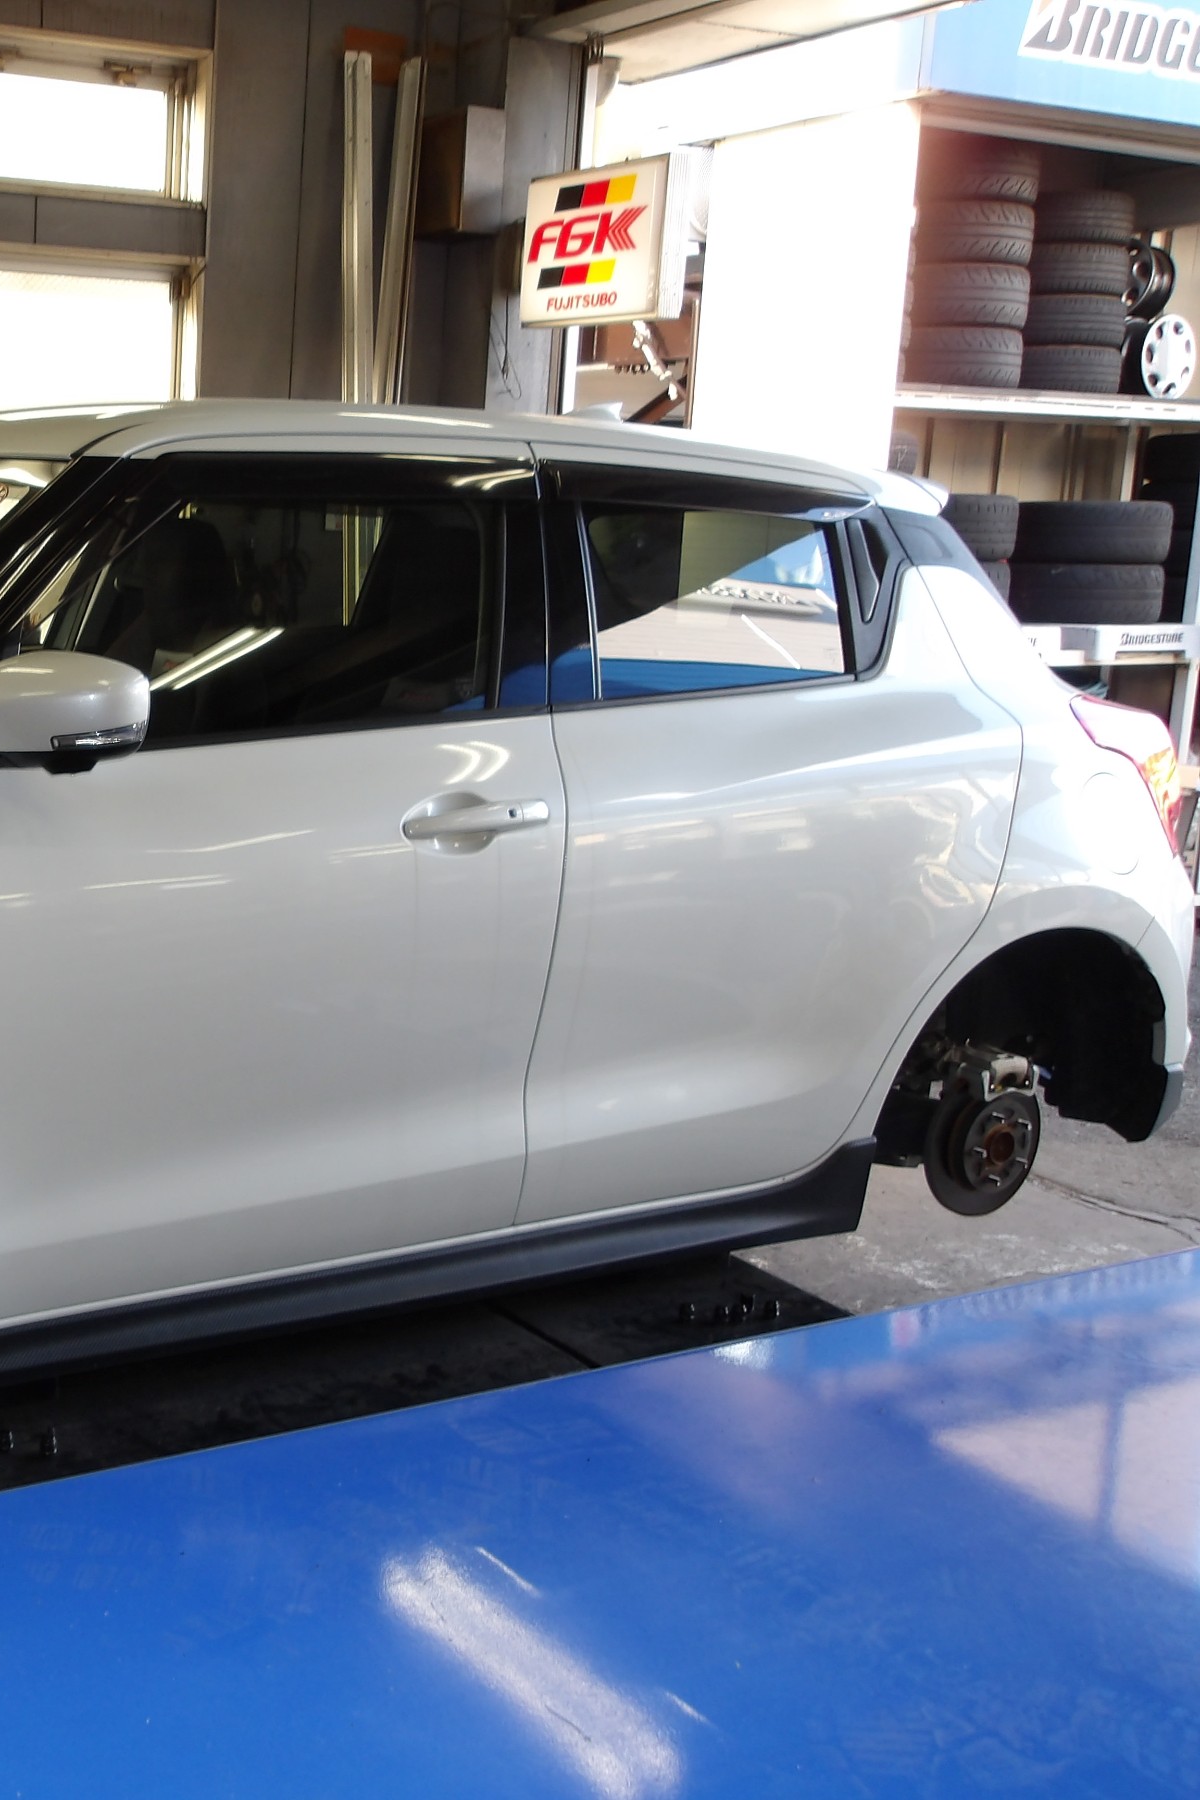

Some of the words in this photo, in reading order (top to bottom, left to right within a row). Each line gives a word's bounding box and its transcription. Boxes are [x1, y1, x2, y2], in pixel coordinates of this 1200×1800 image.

[527, 205, 647, 264] FGK
[546, 292, 618, 312] FUJITSUBO
[1120, 633, 1185, 646] BRIDGESTONE
